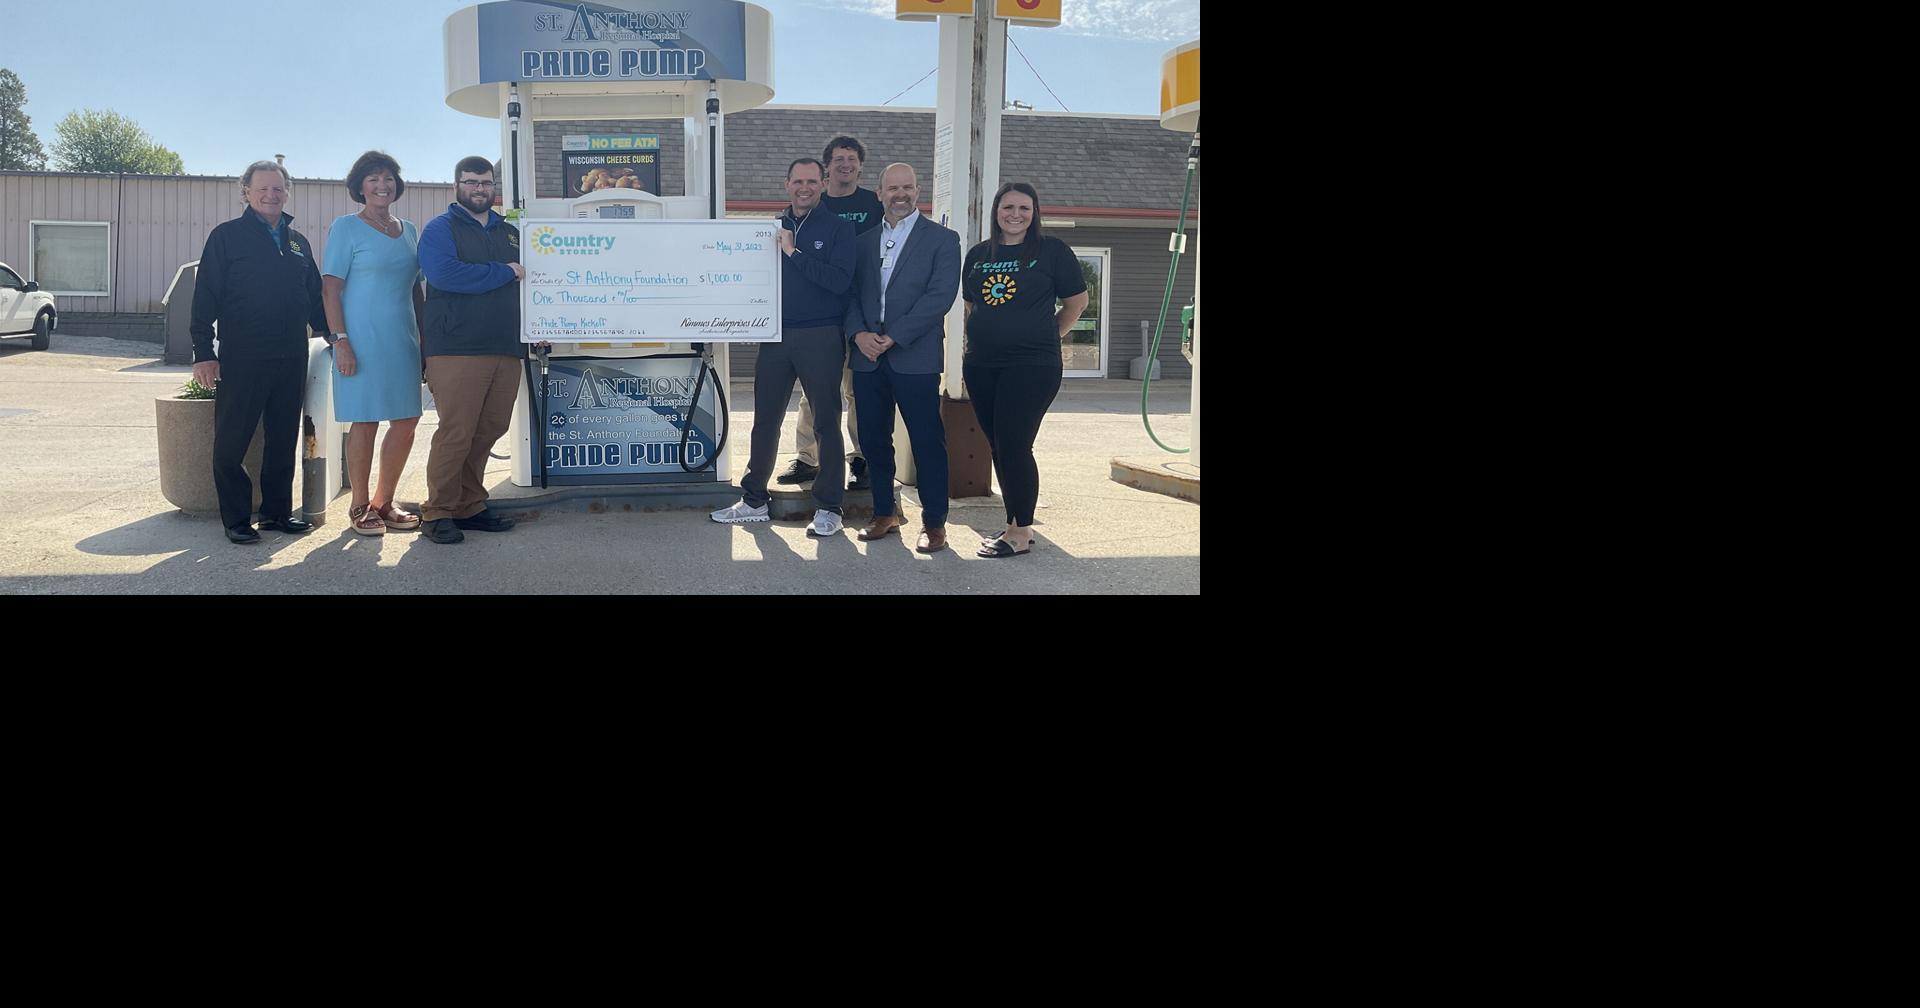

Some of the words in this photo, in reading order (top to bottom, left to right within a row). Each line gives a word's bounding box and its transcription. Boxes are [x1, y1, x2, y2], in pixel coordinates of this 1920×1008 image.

[535, 12, 563, 31] ST.
[562, 3, 691, 42] ANTHONY
[643, 30, 681, 42] Hospital
[521, 50, 611, 78] PRIDE
[619, 49, 706, 77] PUMP
[591, 138, 609, 149] NO
[611, 138, 632, 149] FEE
[633, 137, 657, 149] ATM
[568, 156, 605, 165] WISCONSIN
[606, 155, 631, 164] CHEESE
[632, 154, 655, 164] CURDS
[539, 233, 616, 250] Country
[716, 241, 732, 255] May
[566, 270, 581, 285] St
[585, 270, 633, 291] Anthony
[633, 270, 688, 285] Foundation
[532, 290, 554, 305] One
[556, 290, 607, 304] Thousand
[710, 316, 751, 334] Enterprises
[750, 317, 770, 328] LLC
[608, 397, 650, 409] Regional
[551, 415, 565, 425] 2¢
[568, 414, 580, 424] of
[582, 414, 612, 425] every
[615, 412, 648, 425] gallon
[652, 414, 678, 423] goes
[548, 431, 566, 440] the
[569, 430, 584, 440] St.
[586, 429, 632, 441] Anthony
[628, 441, 704, 466] PUMP
